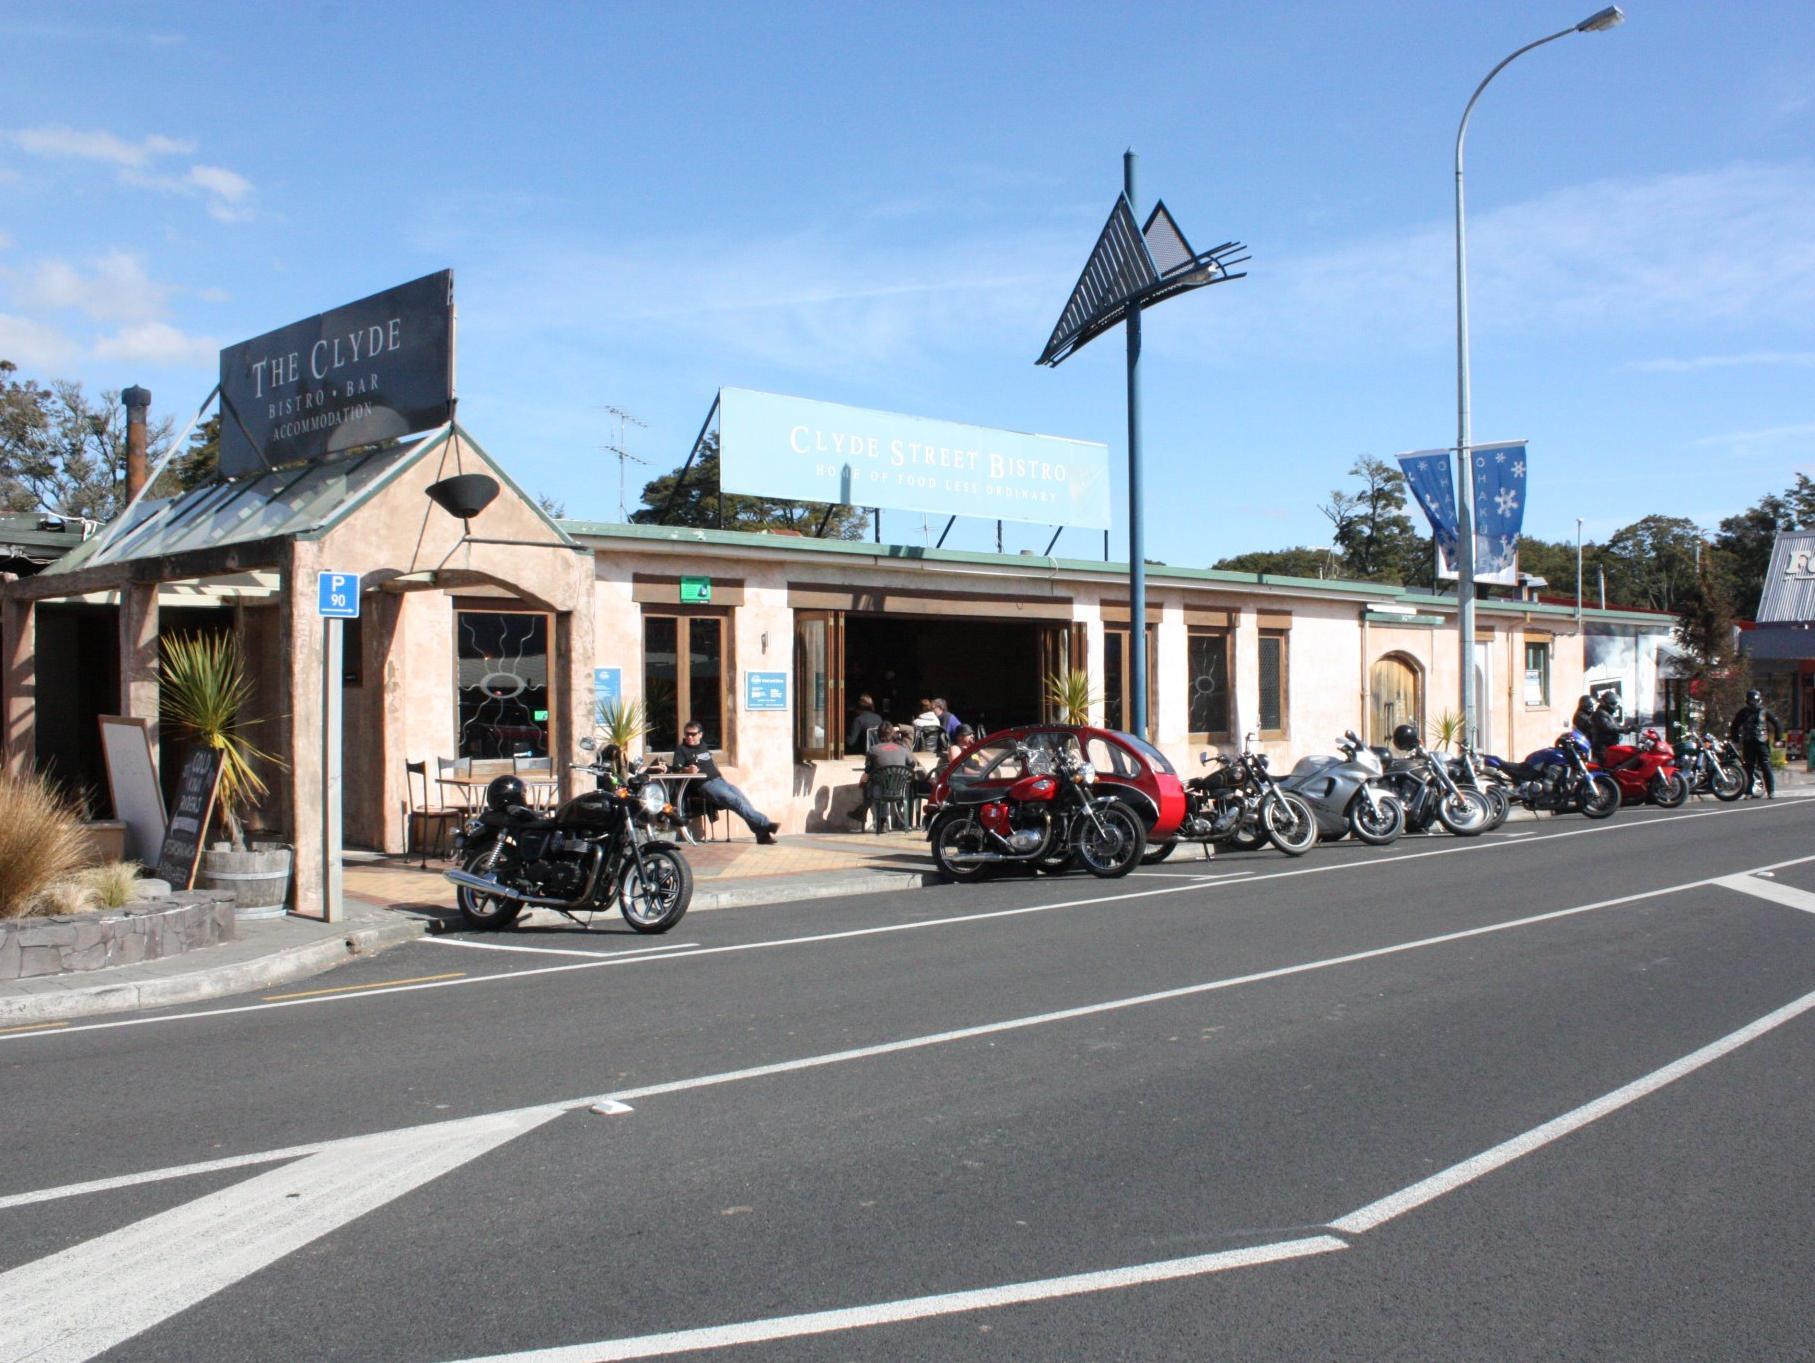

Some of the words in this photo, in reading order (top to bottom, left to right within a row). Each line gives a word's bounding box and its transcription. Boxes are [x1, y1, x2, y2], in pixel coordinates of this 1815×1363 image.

[252, 352, 299, 398] THE
[311, 318, 401, 380] CLYDE
[268, 389, 324, 419] BISTRO
[346, 374, 379, 397] BAR
[272, 401, 373, 441] ACCOMMODATION
[790, 425, 880, 458] CLYDE
[890, 440, 978, 470] STREET
[989, 453, 1067, 481] BISTRO
[870, 471, 888, 482] OF
[897, 474, 937, 489] FOOD
[944, 479, 977, 494] LESS
[985, 485, 1056, 502] ORDINARY
[331, 594, 346, 607] 90
[332, 575, 345, 592] P
